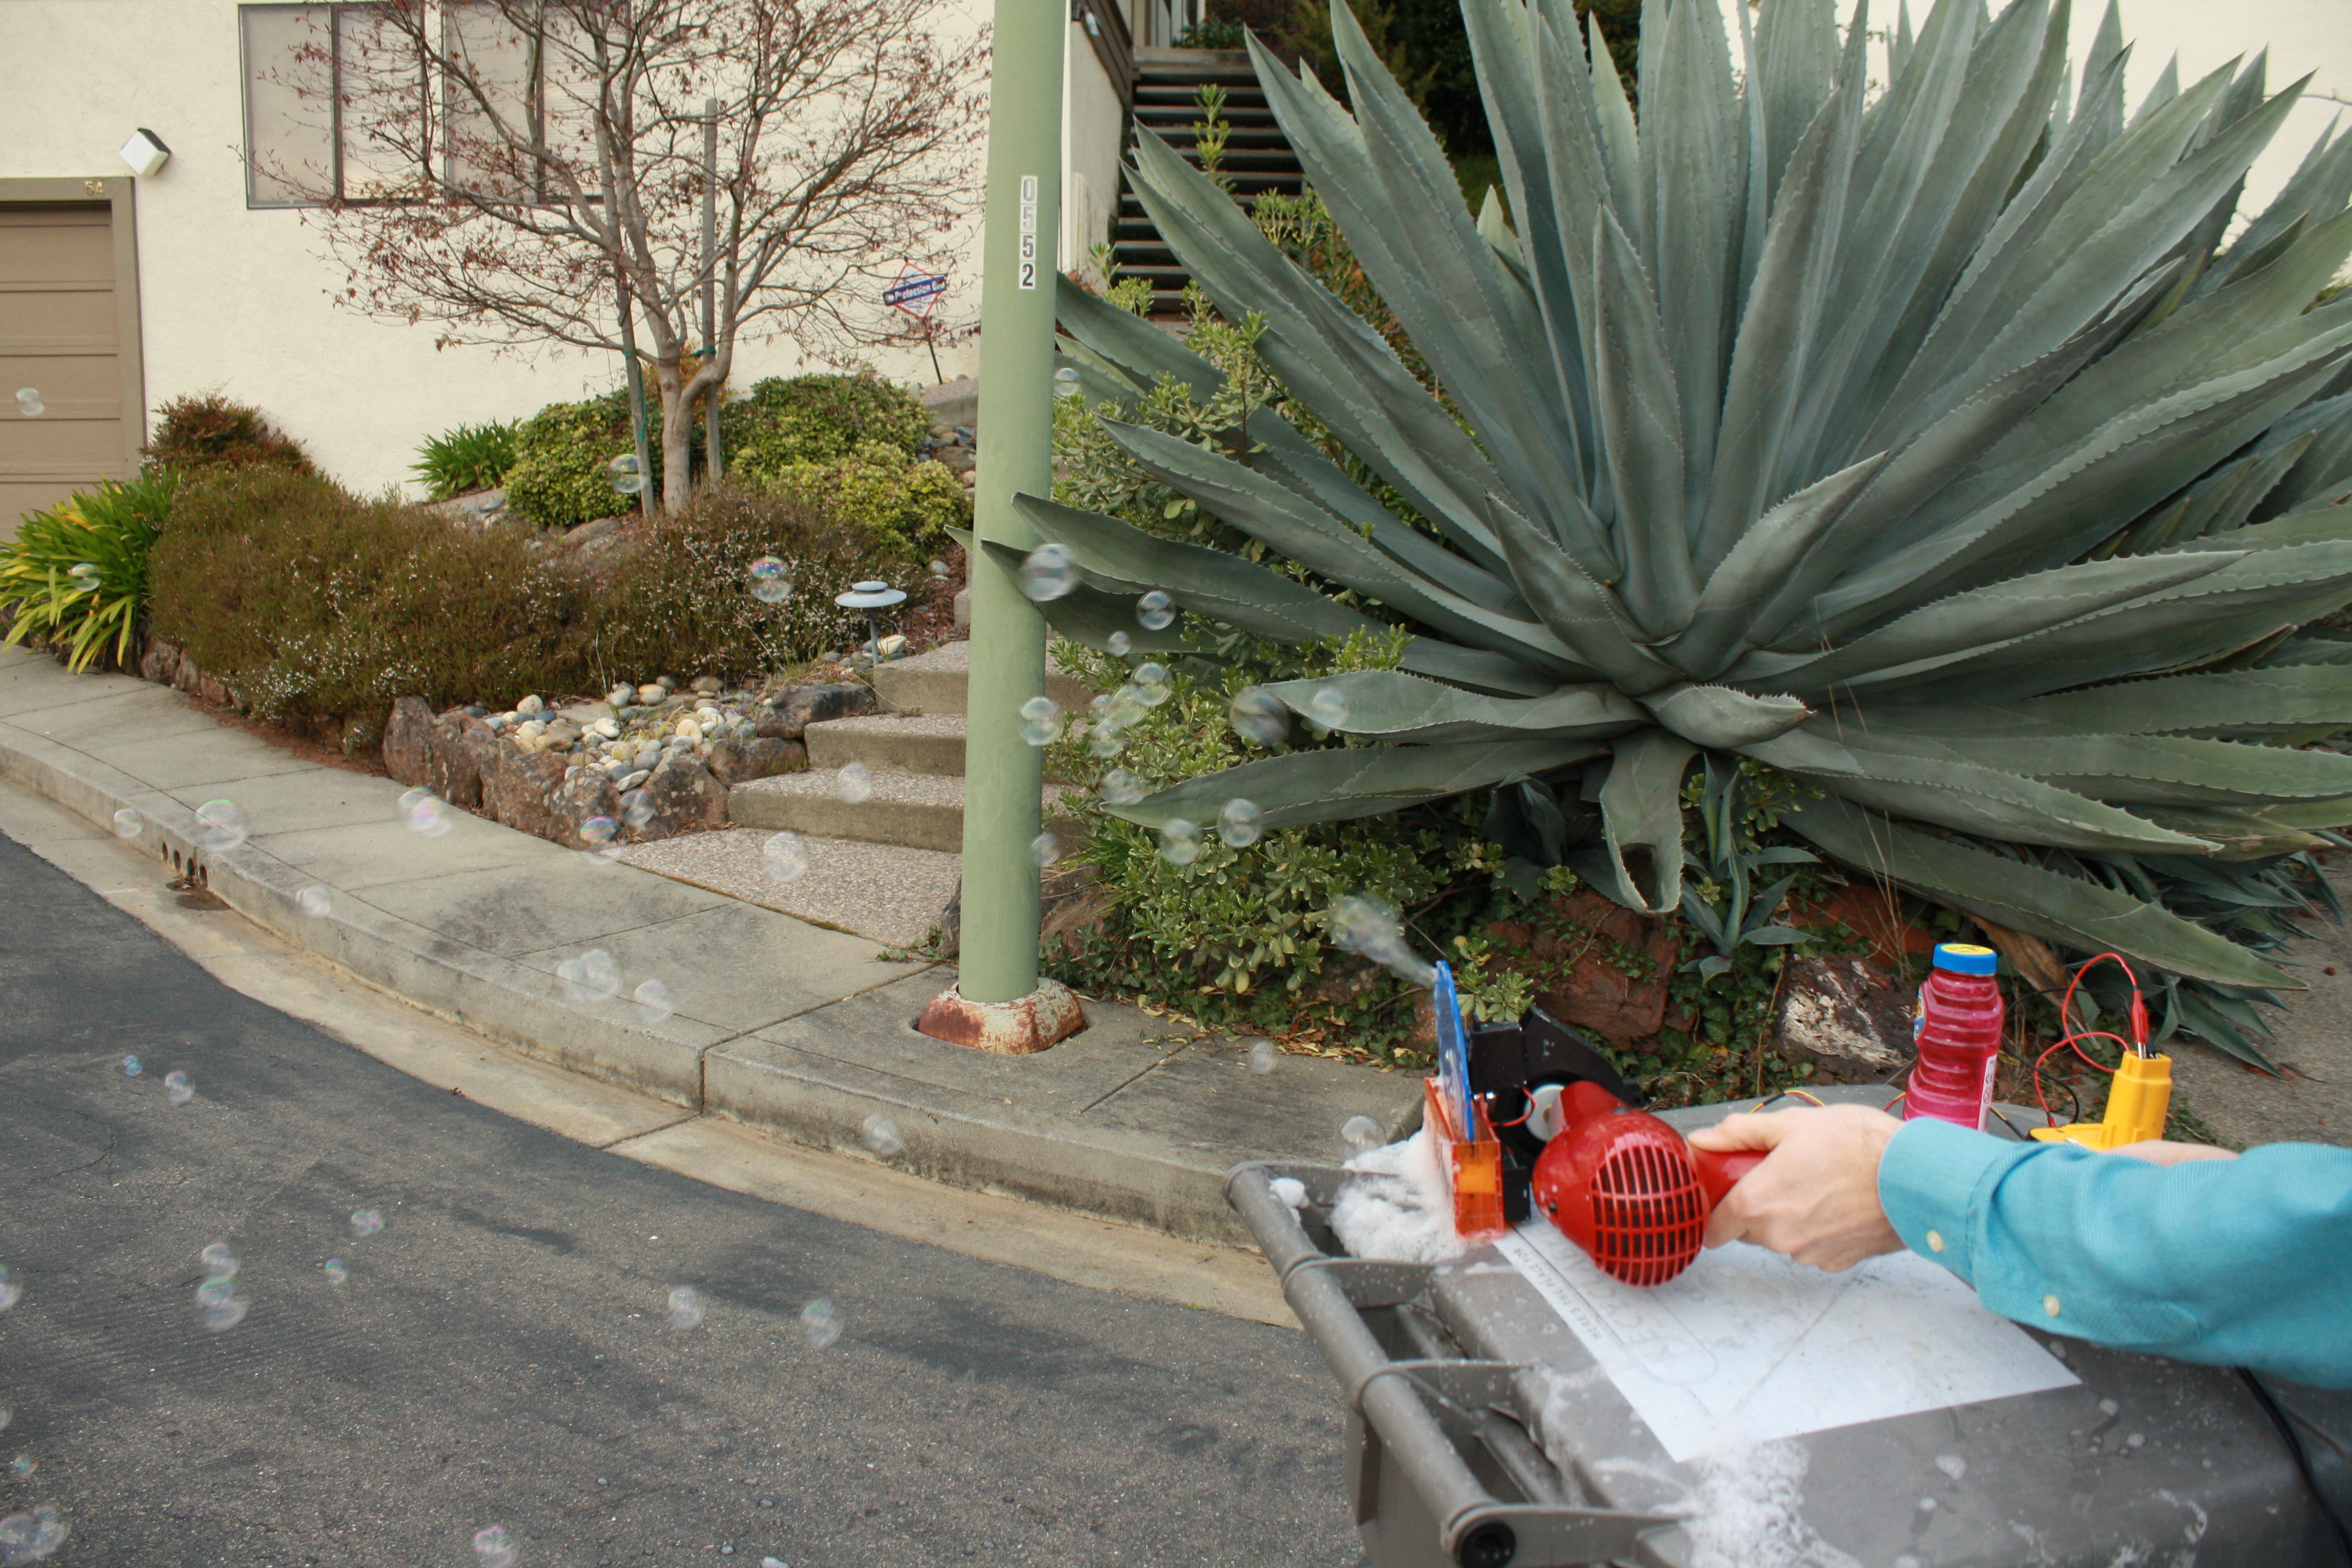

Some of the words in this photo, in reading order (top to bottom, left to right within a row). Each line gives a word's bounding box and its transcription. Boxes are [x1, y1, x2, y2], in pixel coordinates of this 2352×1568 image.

[85, 180, 105, 196] 54
[1022, 177, 1035, 287] 0552
[894, 284, 931, 301] Protection
[1513, 1247, 1532, 1263] FOR
[1527, 1263, 1556, 1288] PLACE
[1553, 1289, 1572, 1306] THE
